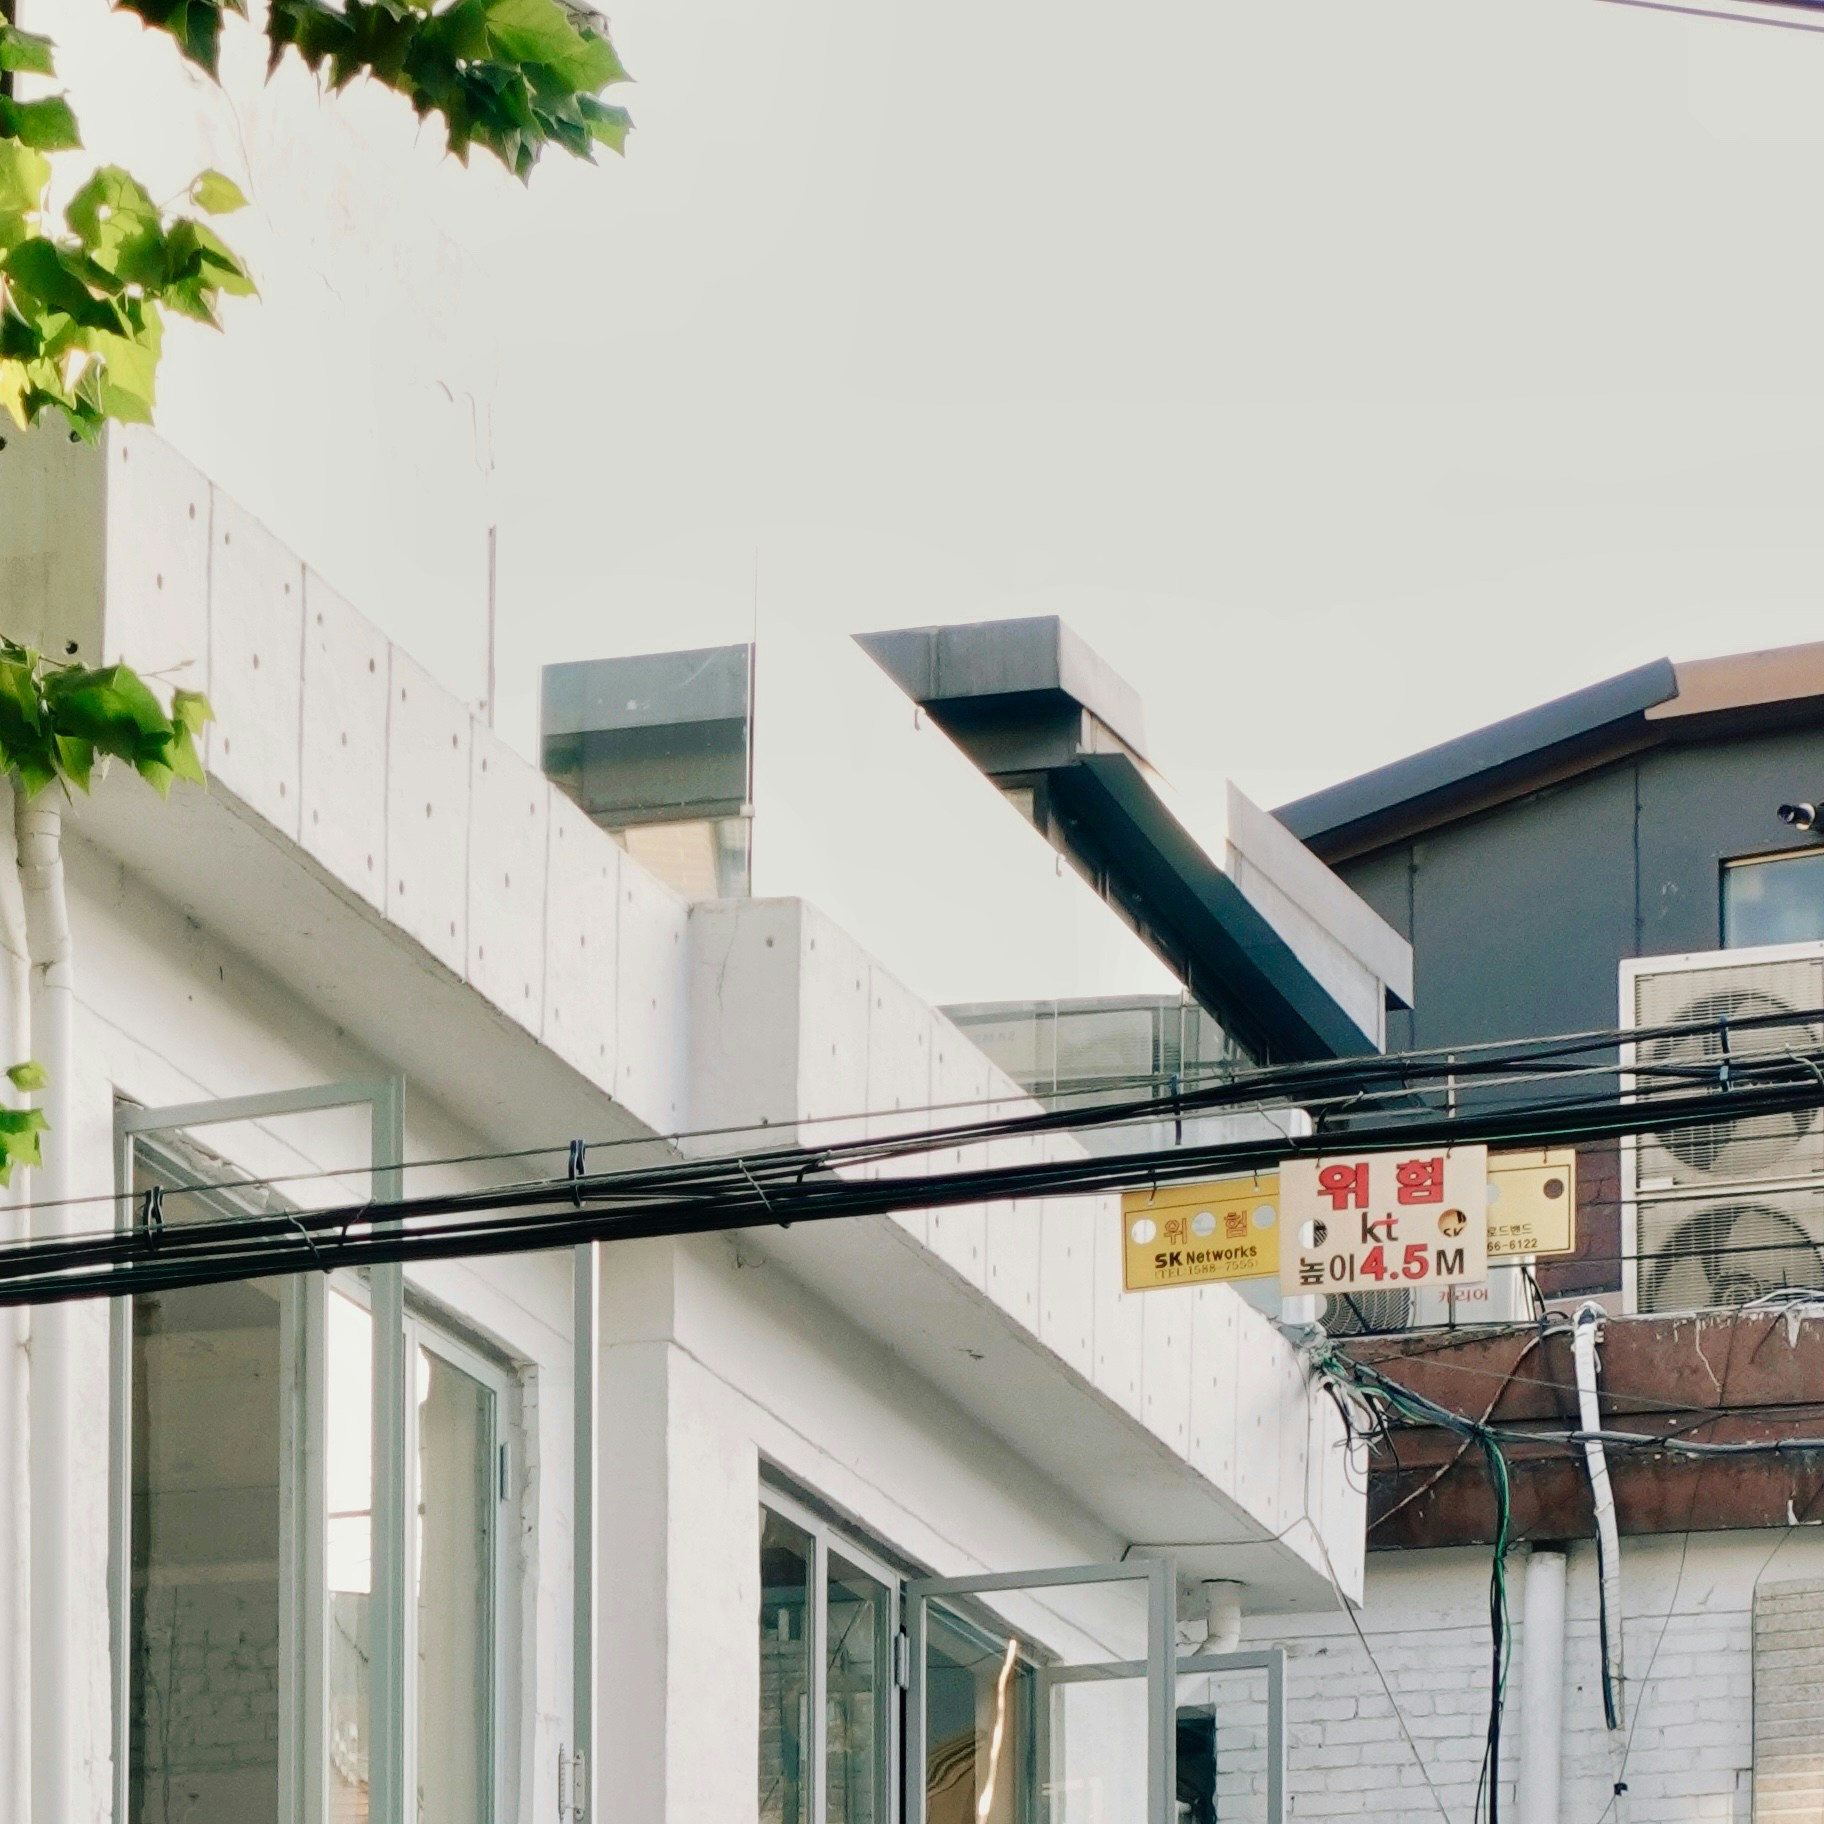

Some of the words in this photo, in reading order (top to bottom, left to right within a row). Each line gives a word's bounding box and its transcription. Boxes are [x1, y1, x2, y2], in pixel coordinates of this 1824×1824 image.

[1361, 1212, 1399, 1244] kt
[1155, 1251, 1183, 1268] SK
[1186, 1245, 1258, 1265] Networks
